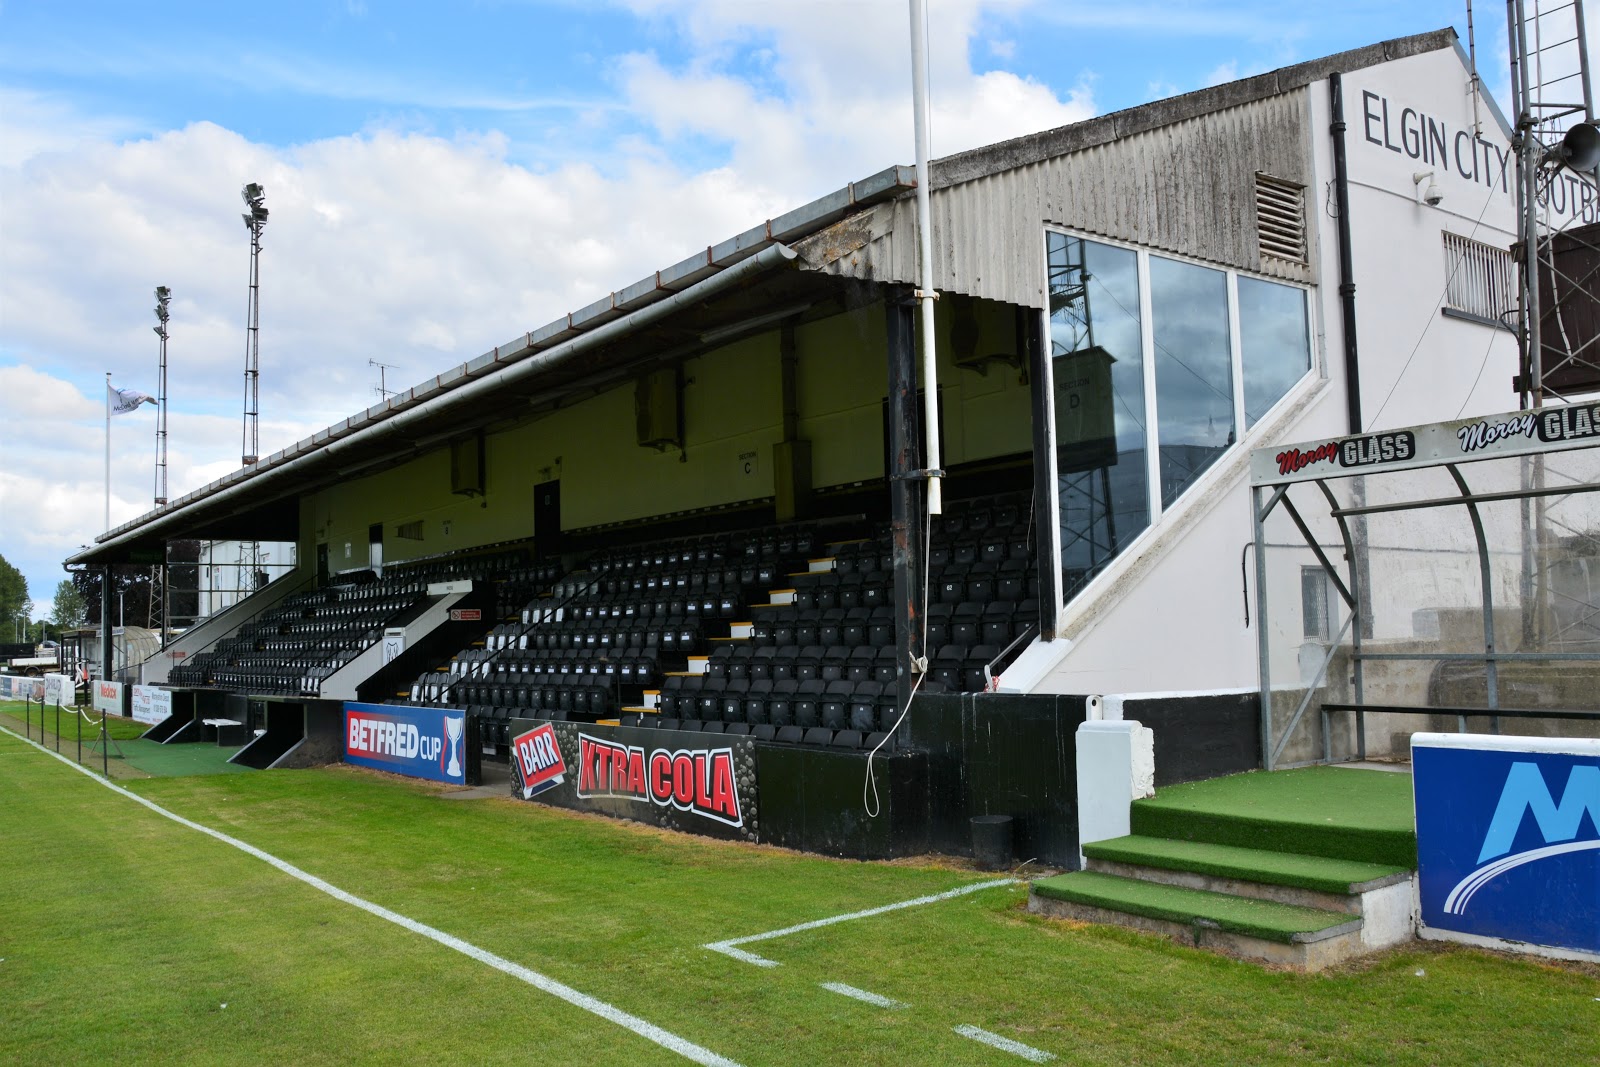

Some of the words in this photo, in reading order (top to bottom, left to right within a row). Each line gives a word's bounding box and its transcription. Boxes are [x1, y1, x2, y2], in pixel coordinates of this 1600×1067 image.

[1362, 89, 1448, 171] ELGIN
[1455, 130, 1513, 193] CITY
[1059, 376, 1089, 390] SECTION
[1070, 394, 1080, 409] D
[1457, 413, 1537, 451] Moray
[1544, 406, 1600, 439] GLAS
[738, 450, 757, 461] SECTION
[744, 462, 751, 474] C
[1276, 442, 1338, 475] Moray
[1344, 434, 1409, 465] GLASS
[349, 717, 419, 759] BETFRED
[420, 735, 441, 761] CUP
[519, 731, 559, 776] BARR
[579, 736, 647, 796] XTRA
[650, 752, 739, 819] COLA
